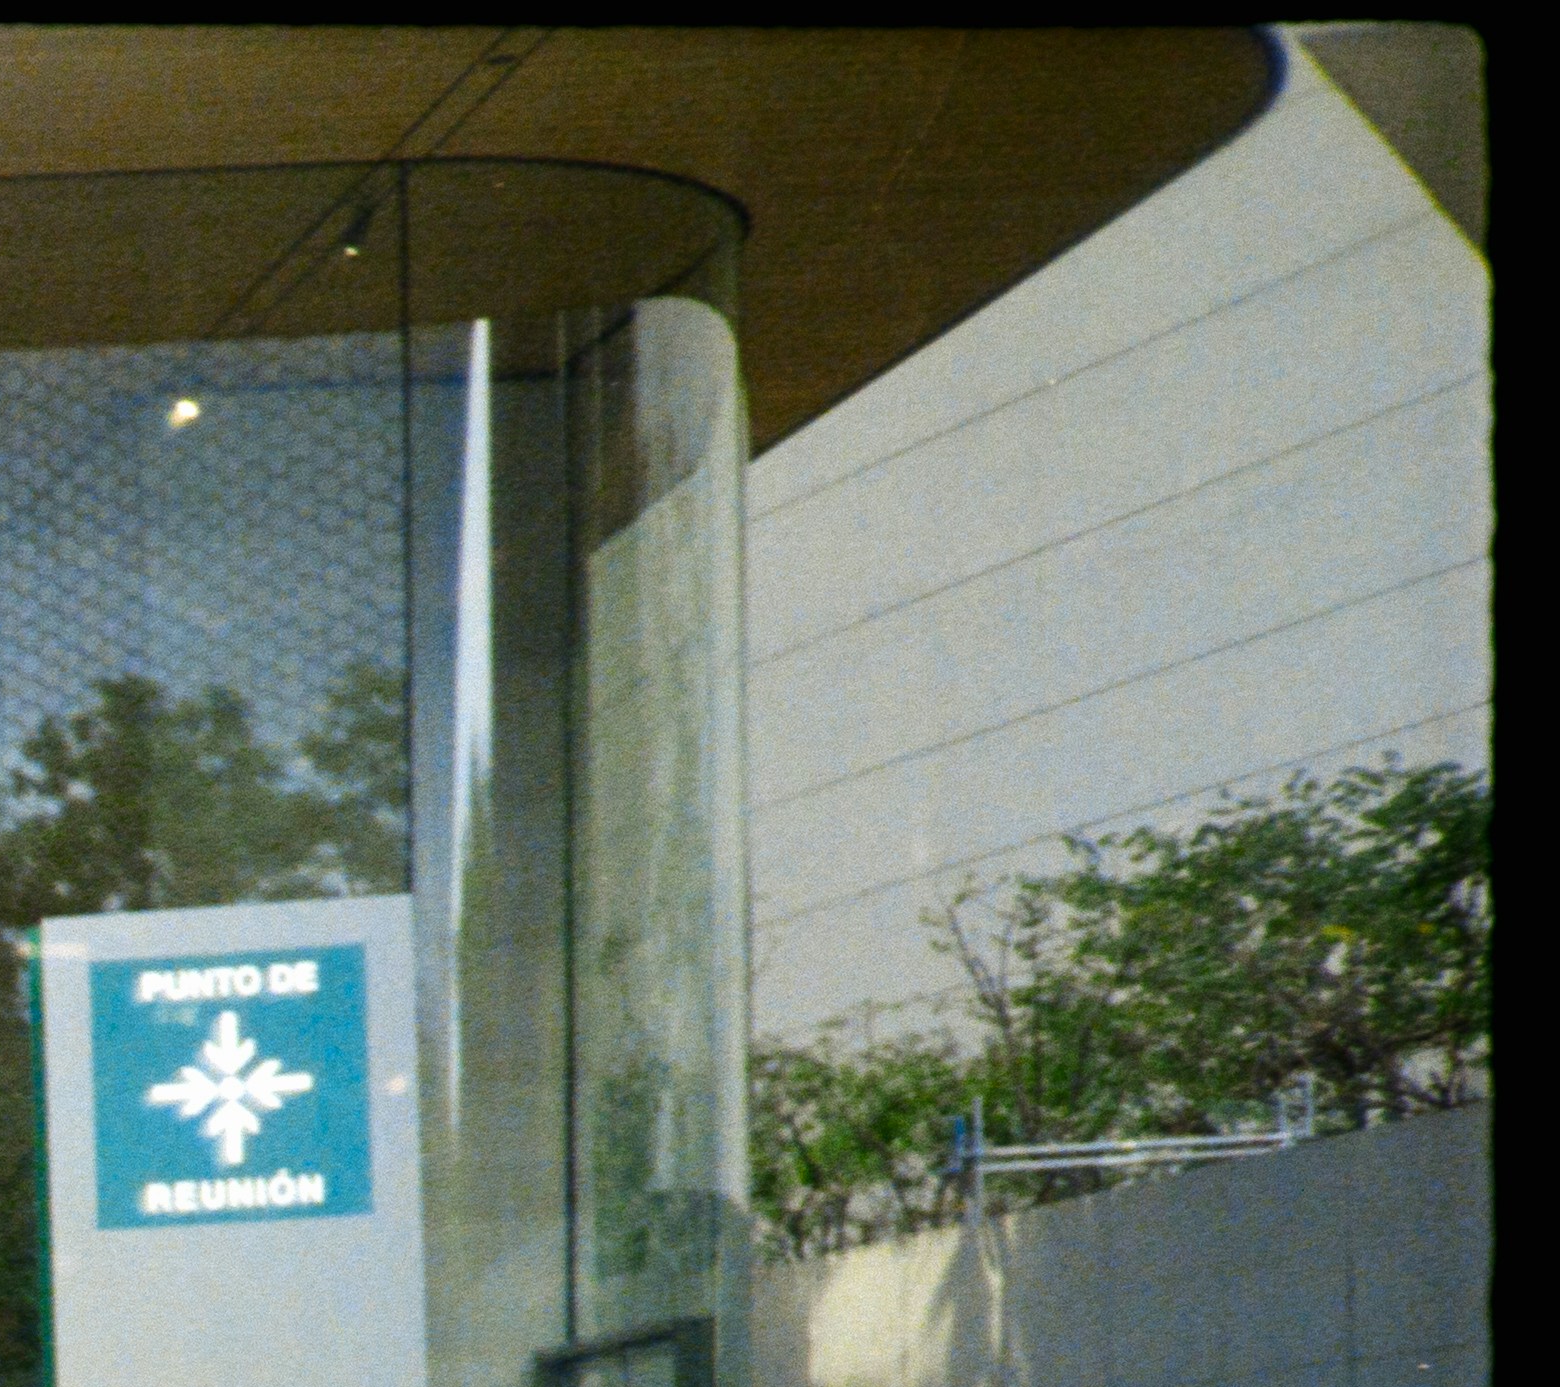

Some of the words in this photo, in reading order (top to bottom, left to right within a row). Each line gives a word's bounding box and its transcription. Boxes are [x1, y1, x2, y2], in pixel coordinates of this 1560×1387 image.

[137, 964, 263, 1003] PUNTO
[268, 960, 319, 995] DE
[142, 1168, 325, 1215] REUNIÓN
